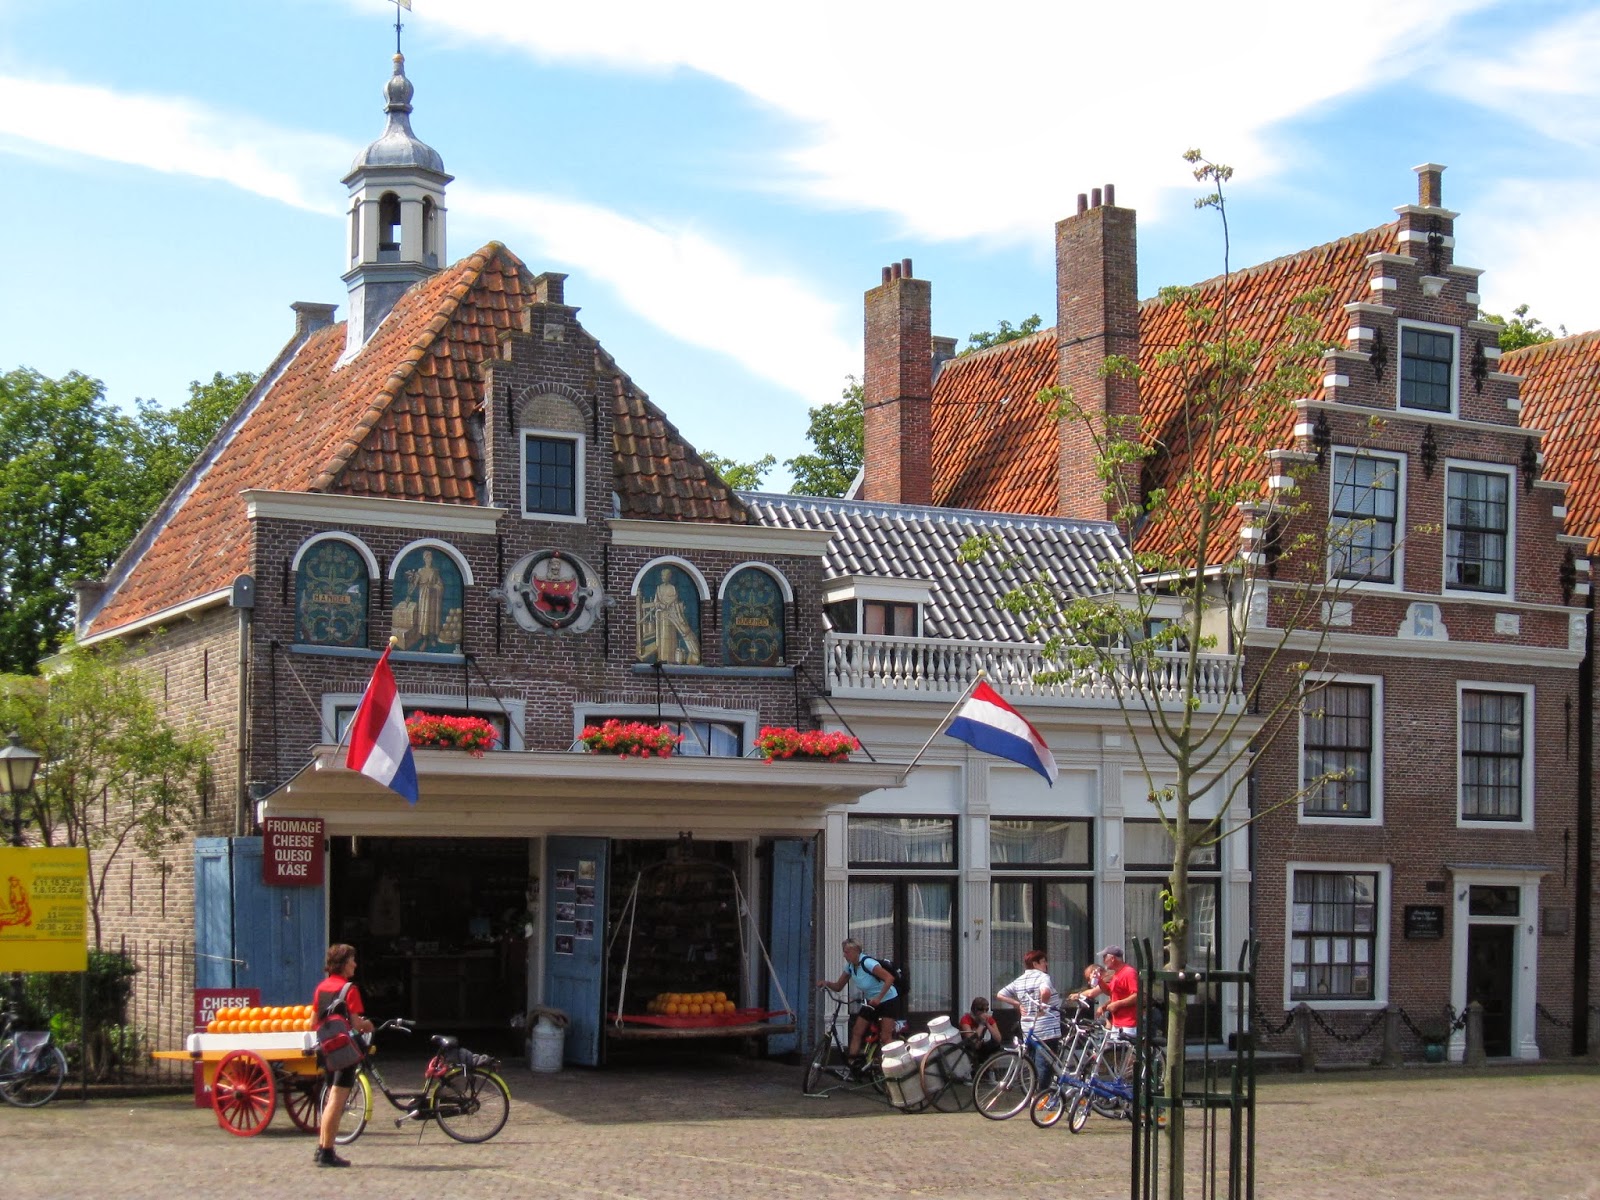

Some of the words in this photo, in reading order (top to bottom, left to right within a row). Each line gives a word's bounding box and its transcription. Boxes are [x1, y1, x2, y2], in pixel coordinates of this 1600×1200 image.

[267, 820, 322, 833] FROMAGE
[272, 834, 315, 847] CHEESE
[274, 849, 312, 862] QUESO
[277, 861, 308, 876] KÄSE
[203, 997, 250, 1009] CHEESE
